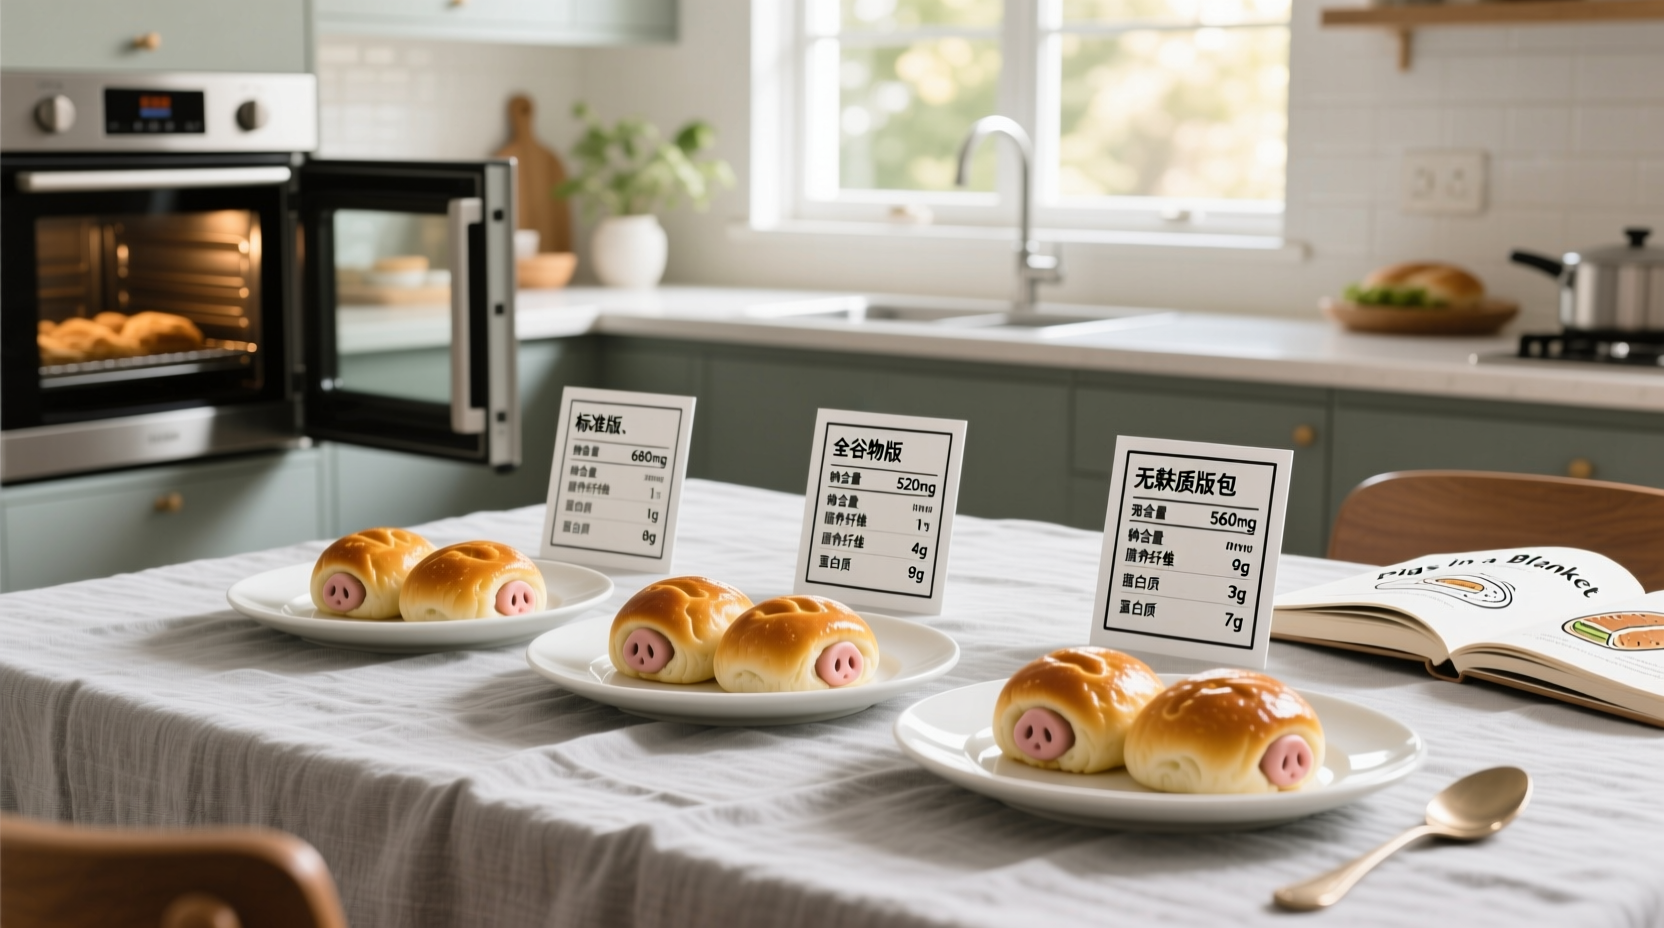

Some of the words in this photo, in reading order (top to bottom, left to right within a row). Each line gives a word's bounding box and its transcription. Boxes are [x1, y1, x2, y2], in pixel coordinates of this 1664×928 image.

[833, 437, 903, 463] 全谷物版
[647, 508, 659, 523] 1g
[1210, 511, 1256, 533] 560mg
[911, 542, 928, 560] 4g
[908, 566, 924, 583] 9g
[1232, 558, 1250, 577] 9g
[1482, 557, 1497, 565] a
[1506, 554, 1599, 599] Blanket
[1227, 585, 1247, 605] 3g
[1225, 612, 1243, 633] 7g
